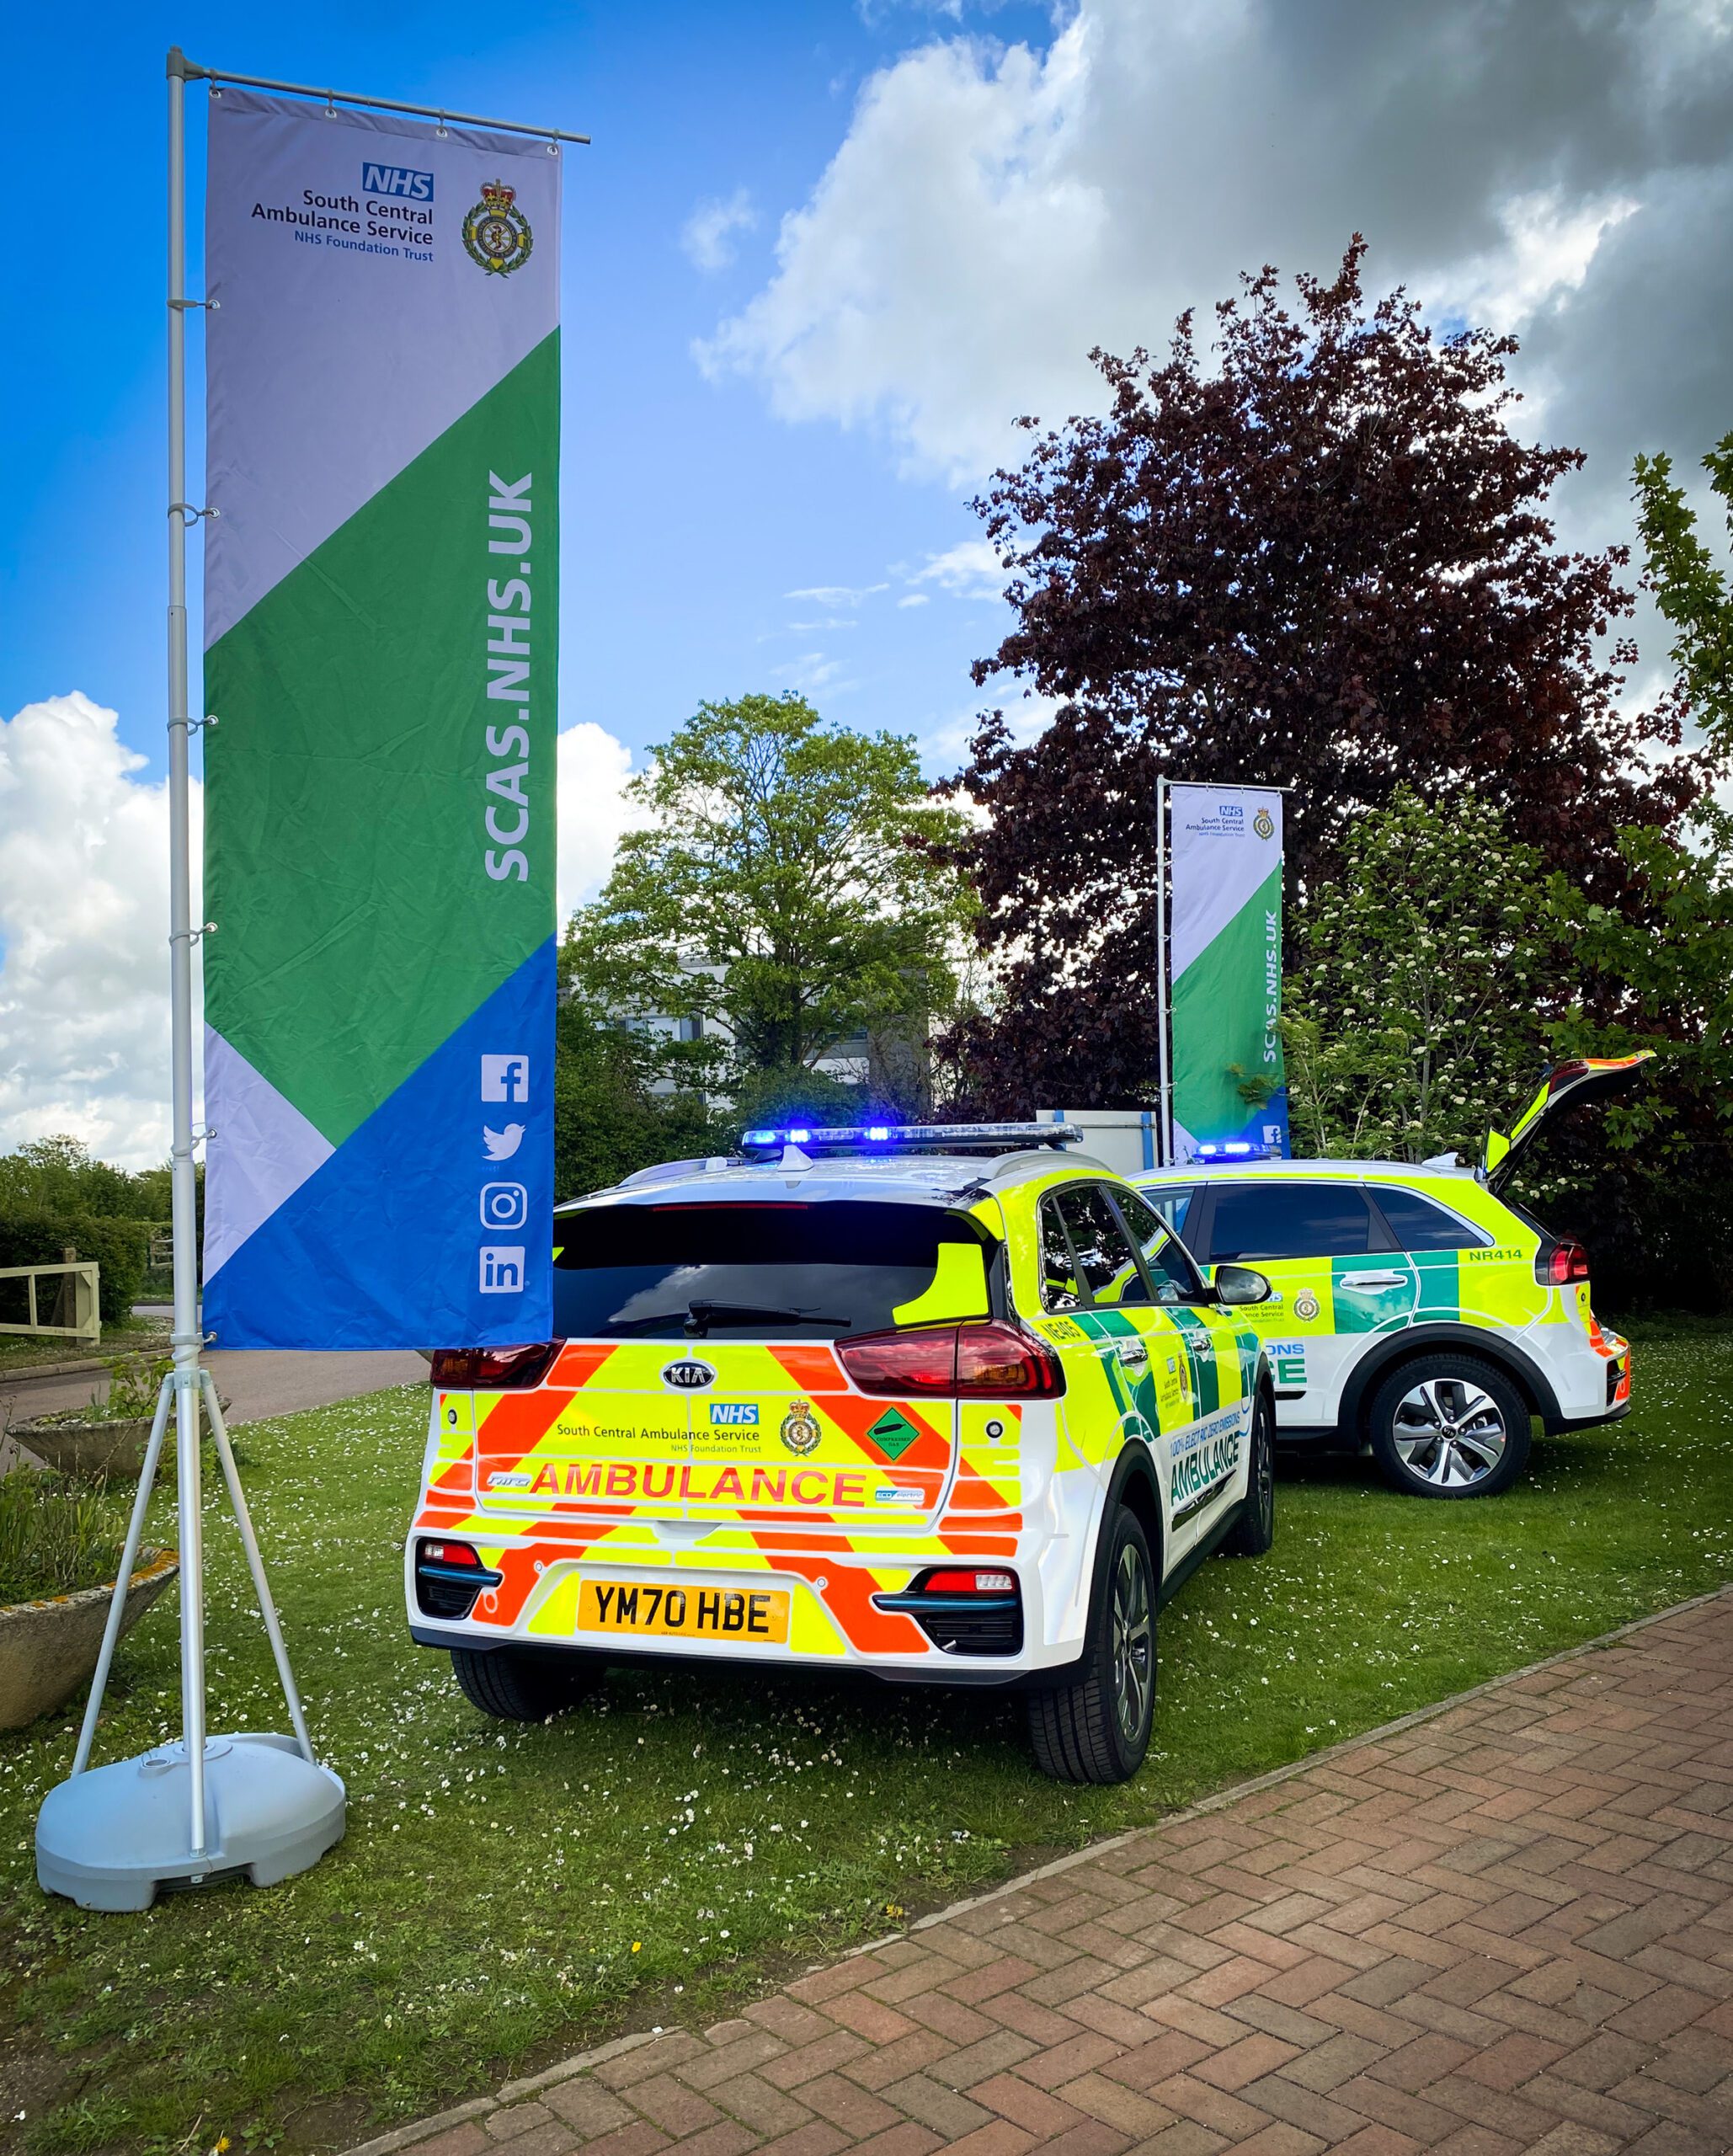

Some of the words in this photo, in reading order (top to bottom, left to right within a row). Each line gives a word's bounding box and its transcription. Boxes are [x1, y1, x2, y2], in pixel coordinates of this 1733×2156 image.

[365, 166, 431, 199] NHS
[303, 189, 359, 213] South
[365, 200, 433, 225] Central
[251, 203, 360, 233] Ambulance
[367, 221, 434, 245] Service
[295, 230, 322, 244] NHS
[326, 235, 399, 257] Foundation
[403, 248, 434, 262] Trust
[485, 469, 532, 882] SCAS.NHS.UK
[1220, 807, 1242, 816] NHS
[1263, 910, 1277, 1063] SCAS.NHS.UK
[1469, 1249, 1522, 1261] NR414
[1040, 1321, 1080, 1341] NE405
[670, 1367, 706, 1384] KIA
[711, 1405, 756, 1424] NHS
[557, 1424, 590, 1436] South
[594, 1426, 636, 1438] Central
[641, 1428, 709, 1440] Ambulance
[714, 1429, 760, 1441] Service
[691, 1444, 737, 1453] Foundation
[1171, 1429, 1240, 1507] AMBULANCE
[529, 1463, 866, 1508] AMBULANCE
[595, 1586, 686, 1628] YM70
[697, 1591, 771, 1633] HBE
